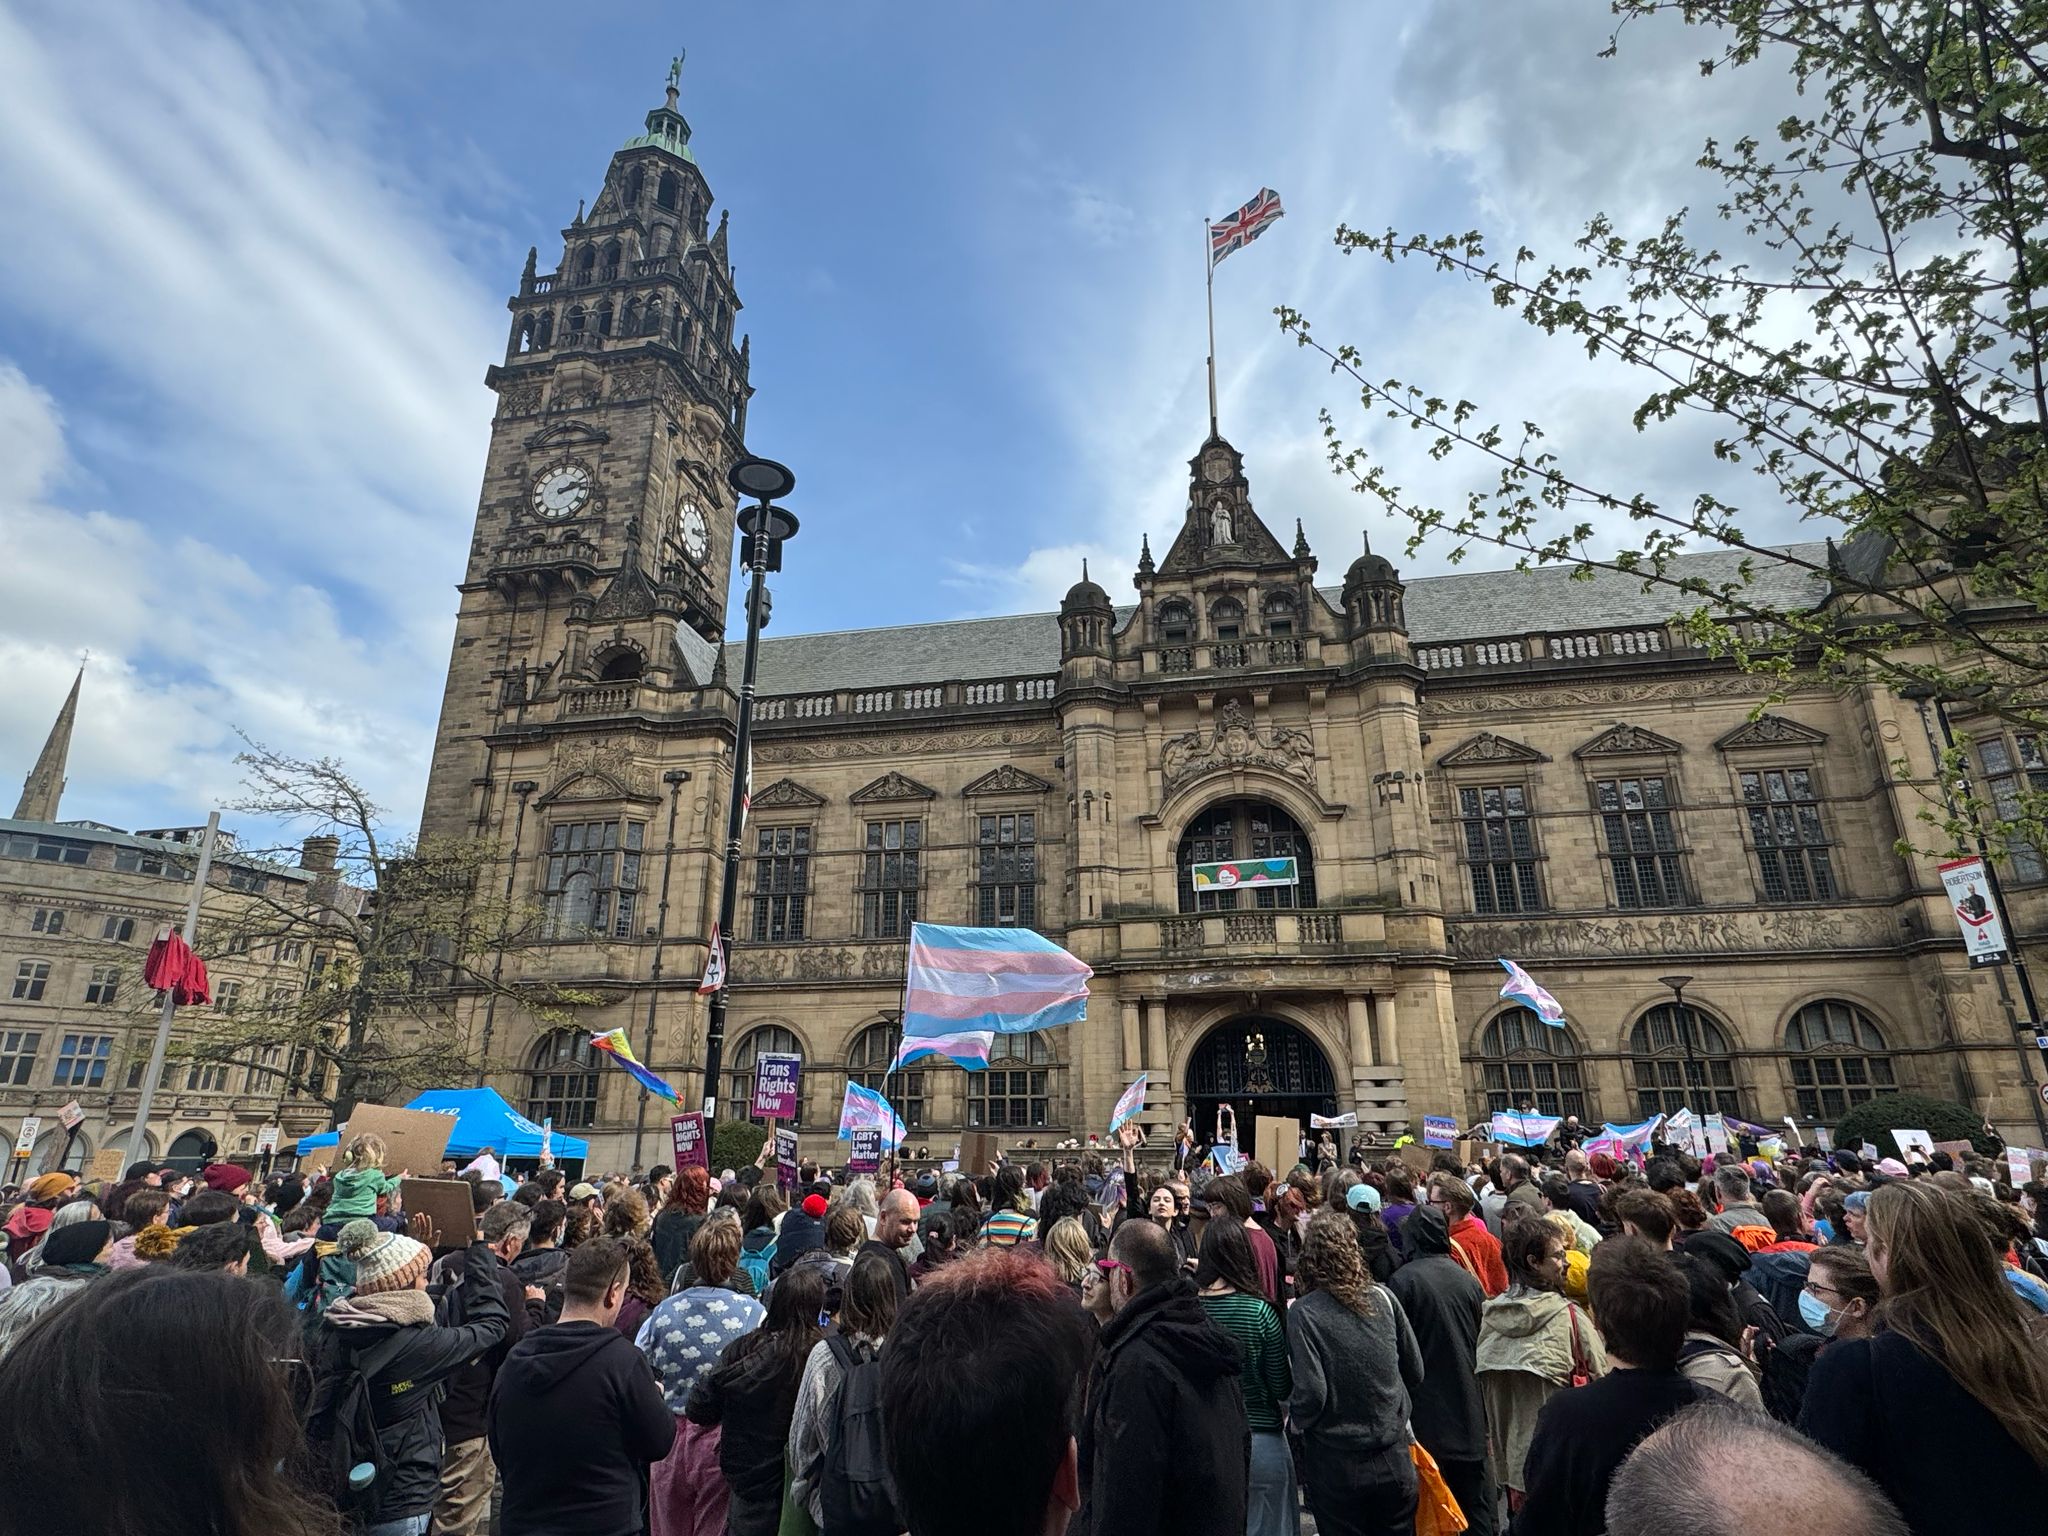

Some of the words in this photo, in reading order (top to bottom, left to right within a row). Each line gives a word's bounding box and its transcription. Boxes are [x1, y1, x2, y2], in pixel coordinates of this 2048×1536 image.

[1945, 871, 1982, 886] ROBERTSON
[760, 1060, 790, 1077] Trans
[758, 1076, 796, 1096] Rights
[757, 1093, 781, 1110] Now
[675, 1119, 697, 1132] TRANS
[676, 1129, 700, 1142] RIGHTS
[852, 1131, 878, 1141] LGBT+
[677, 1140, 693, 1152] NOW
[852, 1142, 872, 1150] Lives
[851, 1150, 879, 1160] Matter
